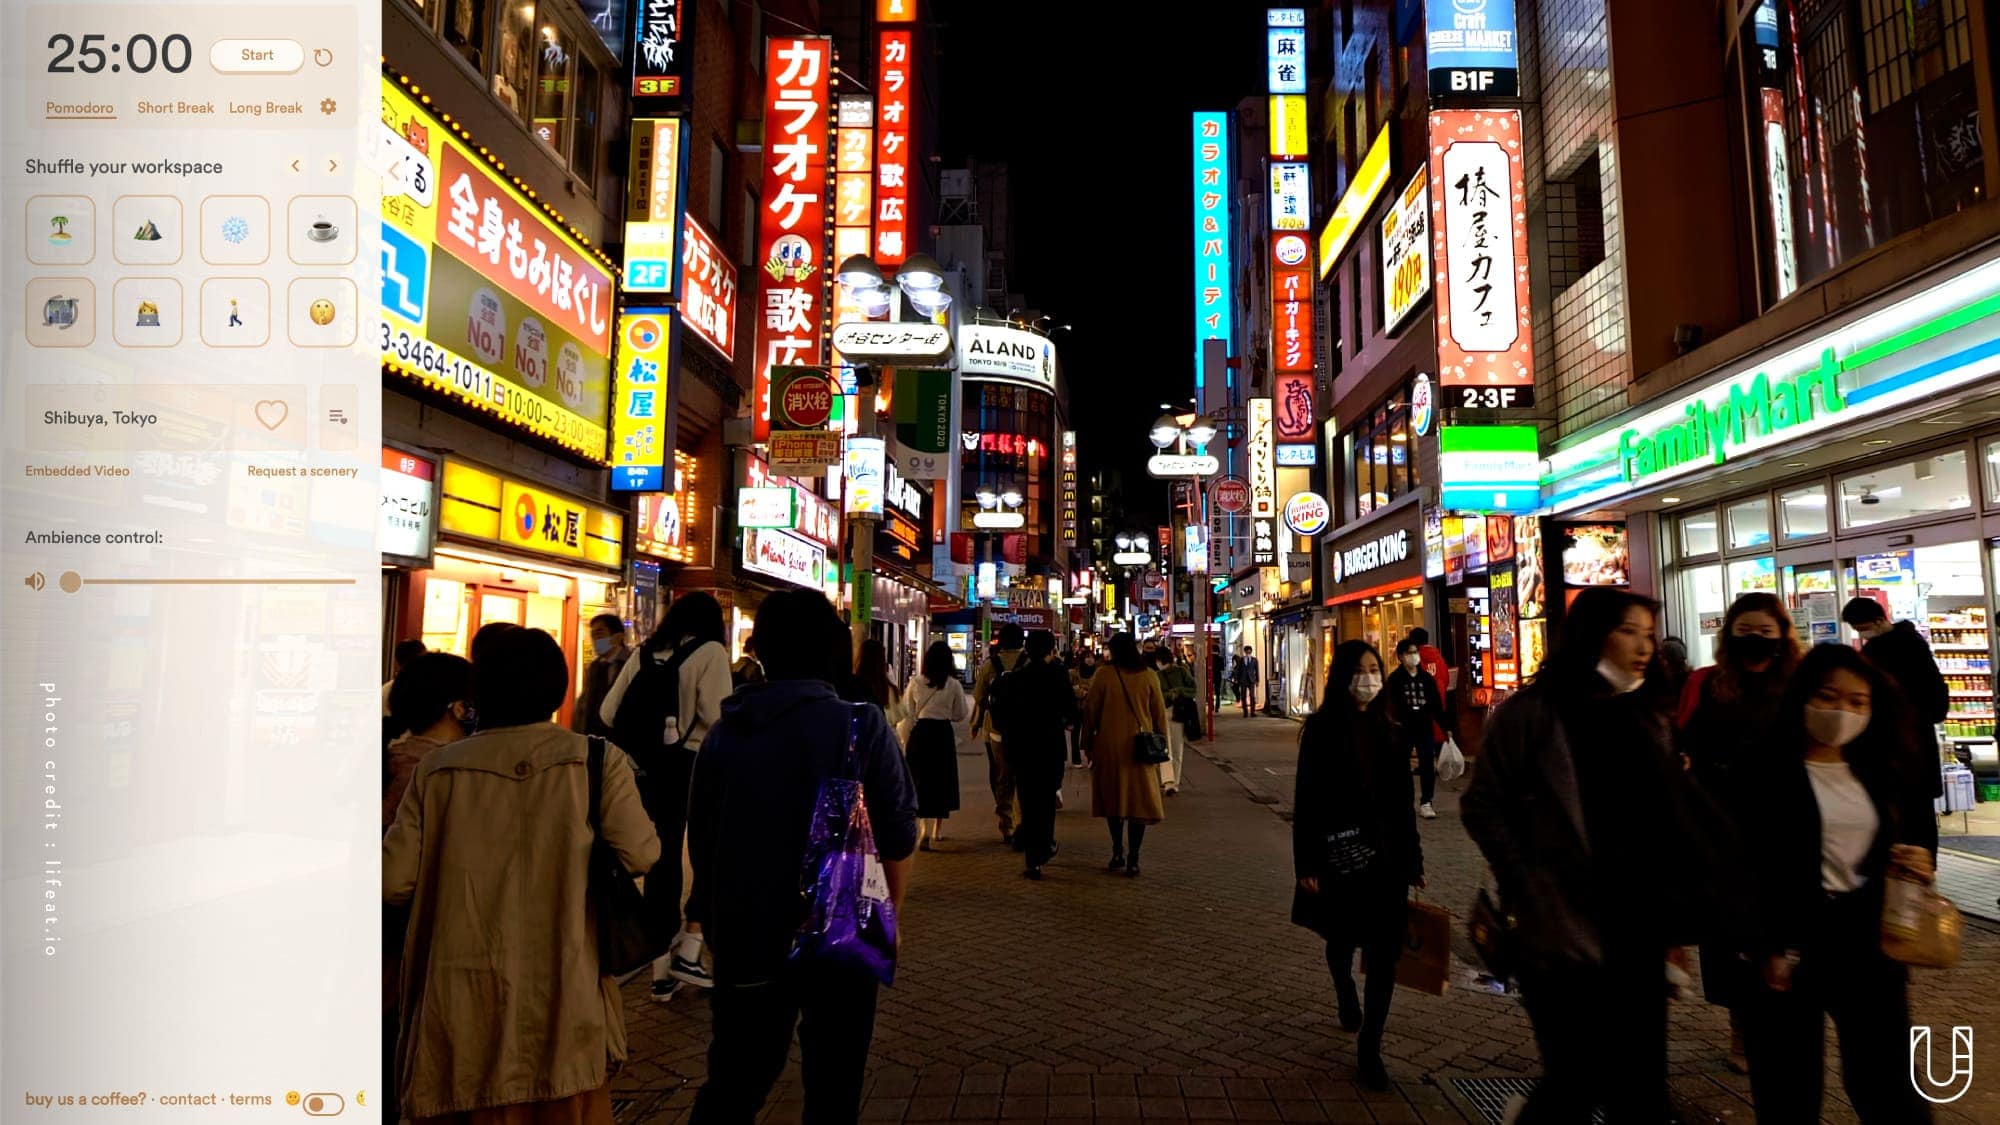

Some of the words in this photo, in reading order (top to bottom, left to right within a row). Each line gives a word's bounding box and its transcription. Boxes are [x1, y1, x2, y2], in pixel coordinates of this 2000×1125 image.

[1465, 30, 1512, 48] MARKET
[1277, 38, 1297, 82] 麻雀
[639, 79, 675, 93] 3F
[1451, 71, 1494, 91] B1F
[769, 41, 821, 230] カラオケ
[878, 40, 907, 256] カラオケ歌広場
[1202, 120, 1222, 339] カラオケ&パーティ
[448, 172, 605, 337] 全身もみほぐし
[1454, 166, 1500, 327] 椿屋カフェ
[633, 265, 664, 285] 2F
[683, 227, 735, 306] カラオケ
[1284, 275, 1301, 367] バーガーキング
[968, 358, 993, 366] TOKYO
[629, 358, 658, 417] 松屋
[787, 391, 830, 412] 消火栓
[937, 393, 948, 424] TOKYO
[1618, 346, 1848, 483] FamilyMart
[774, 440, 814, 449] iPhone
[937, 425, 948, 448] 2020
[630, 479, 644, 488] 1F
[1291, 500, 1322, 515] BURGER
[1292, 510, 1325, 525] KING
[542, 504, 580, 548] 松屋
[1343, 542, 1380, 577] BURGER
[1379, 528, 1408, 564] KING
[990, 612, 1044, 624] McDnald's
